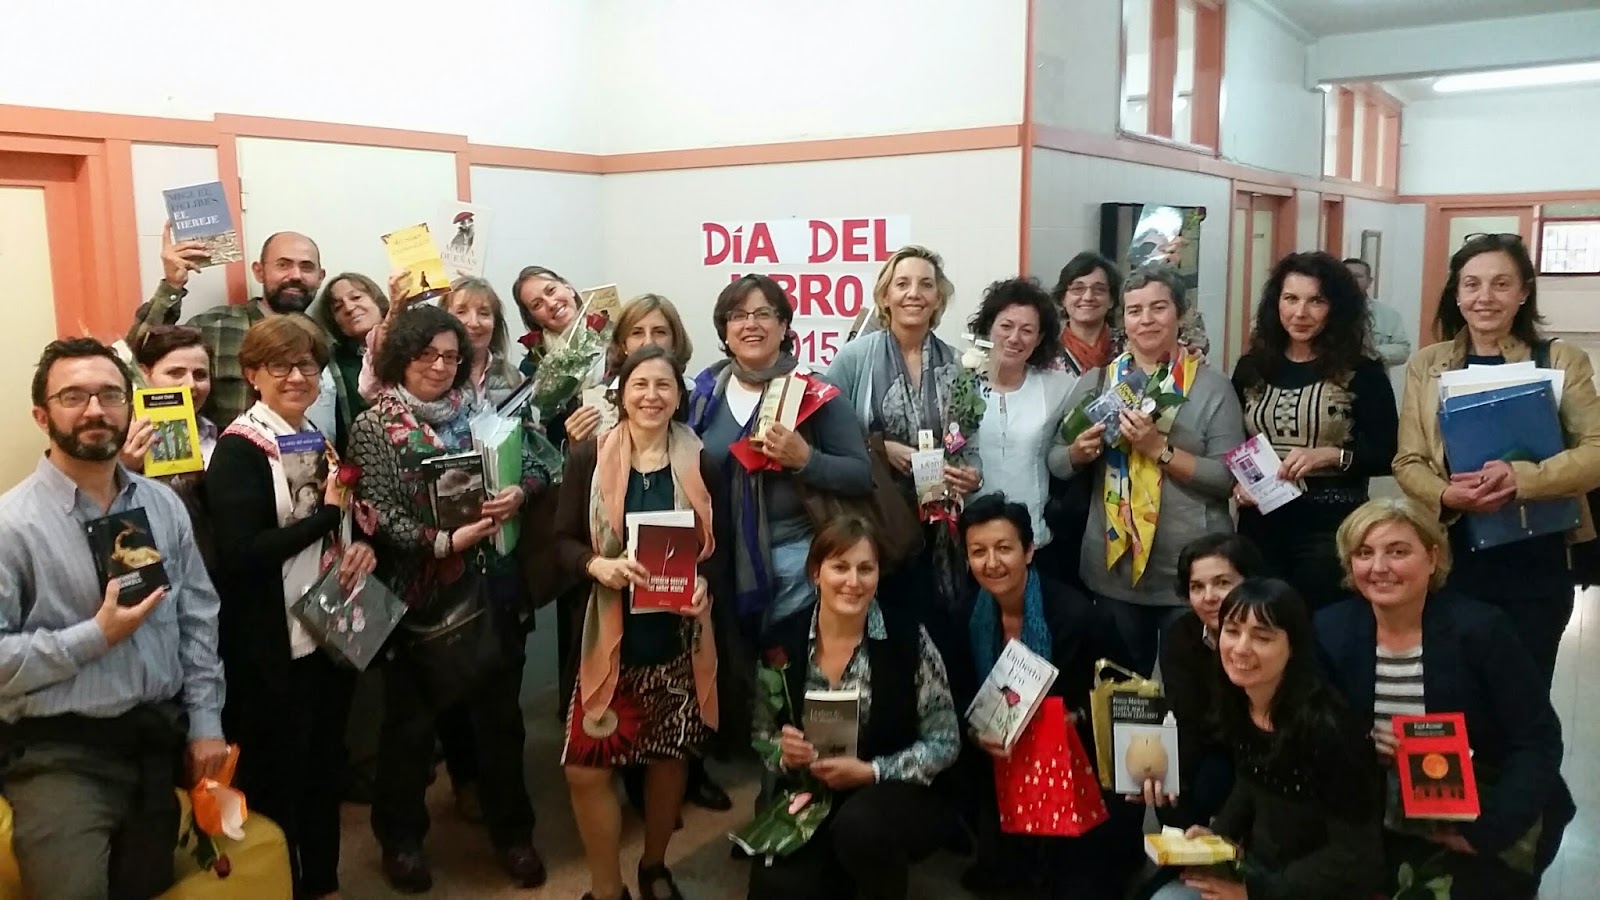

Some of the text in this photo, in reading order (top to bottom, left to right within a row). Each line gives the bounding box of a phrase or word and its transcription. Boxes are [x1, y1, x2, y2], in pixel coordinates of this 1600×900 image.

[173, 210, 189, 220] EL
[176, 215, 220, 230] HEREJE
[808, 219, 898, 263] DEL
[731, 274, 863, 317] BRO
[788, 330, 839, 365] 15
[1006, 648, 1041, 681] Umberto
